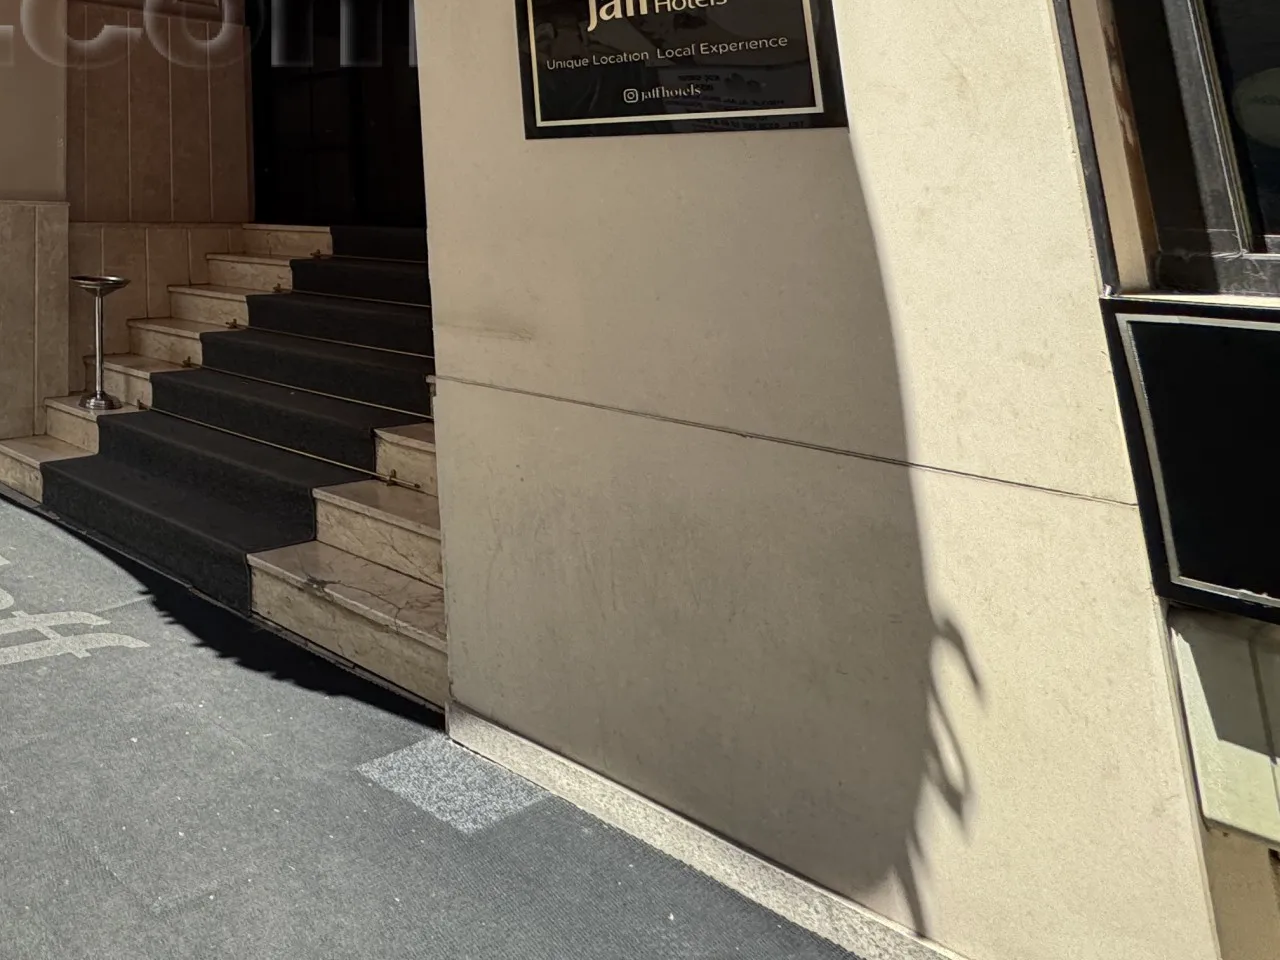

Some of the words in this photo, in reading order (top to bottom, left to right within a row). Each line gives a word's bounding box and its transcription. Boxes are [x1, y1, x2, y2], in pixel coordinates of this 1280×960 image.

[546, 57, 589, 70] Unique
[592, 51, 649, 66] Location
[657, 43, 696, 60] Local
[700, 36, 788, 56] Experience
